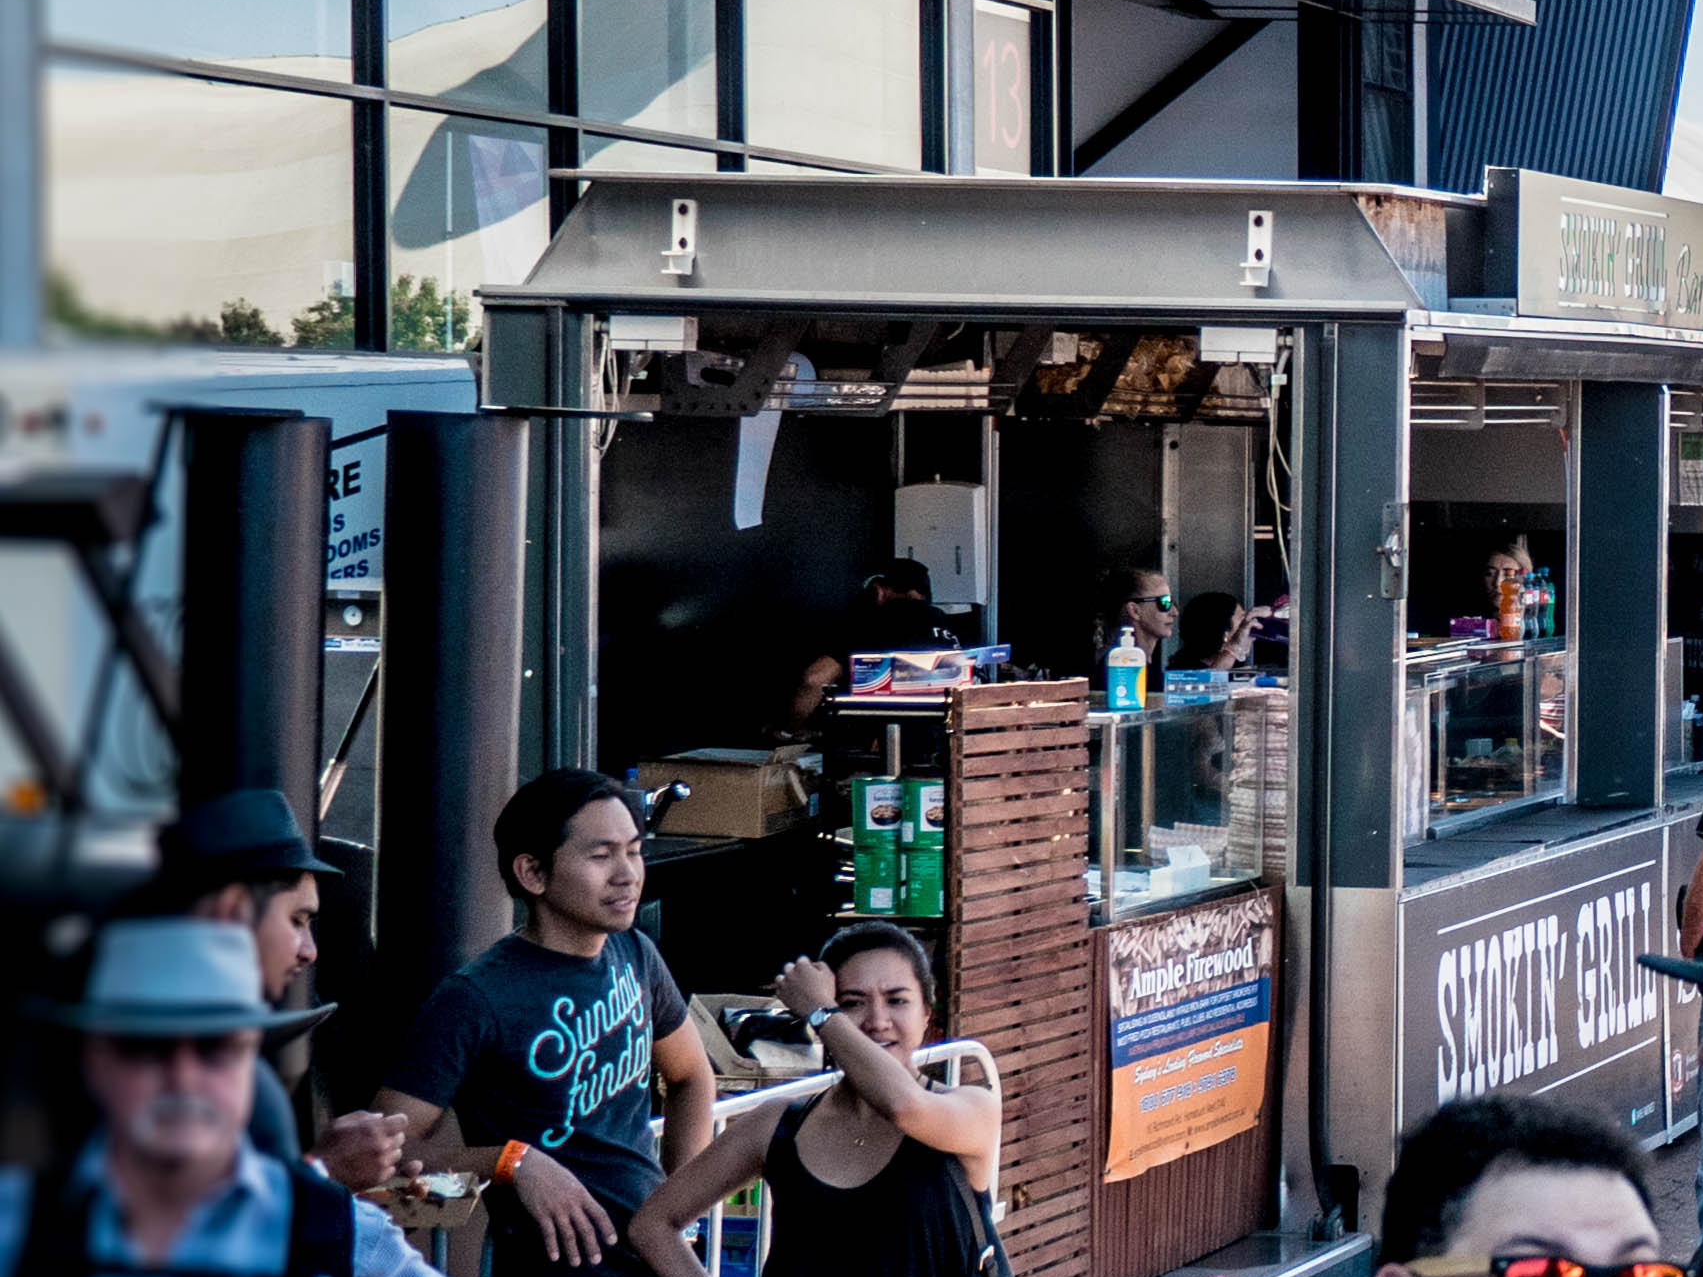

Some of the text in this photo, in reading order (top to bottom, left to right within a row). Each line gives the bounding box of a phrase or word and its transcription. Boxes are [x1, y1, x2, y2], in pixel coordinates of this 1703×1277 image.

[983, 40, 1024, 149] 13
[1624, 222, 1667, 302] GRILL
[528, 962, 645, 1079] Sunday
[1128, 937, 1254, 1002] Ample Firewood
[1436, 915, 1567, 1105] SMOKIN'
[1575, 881, 1658, 1049] GRILL
